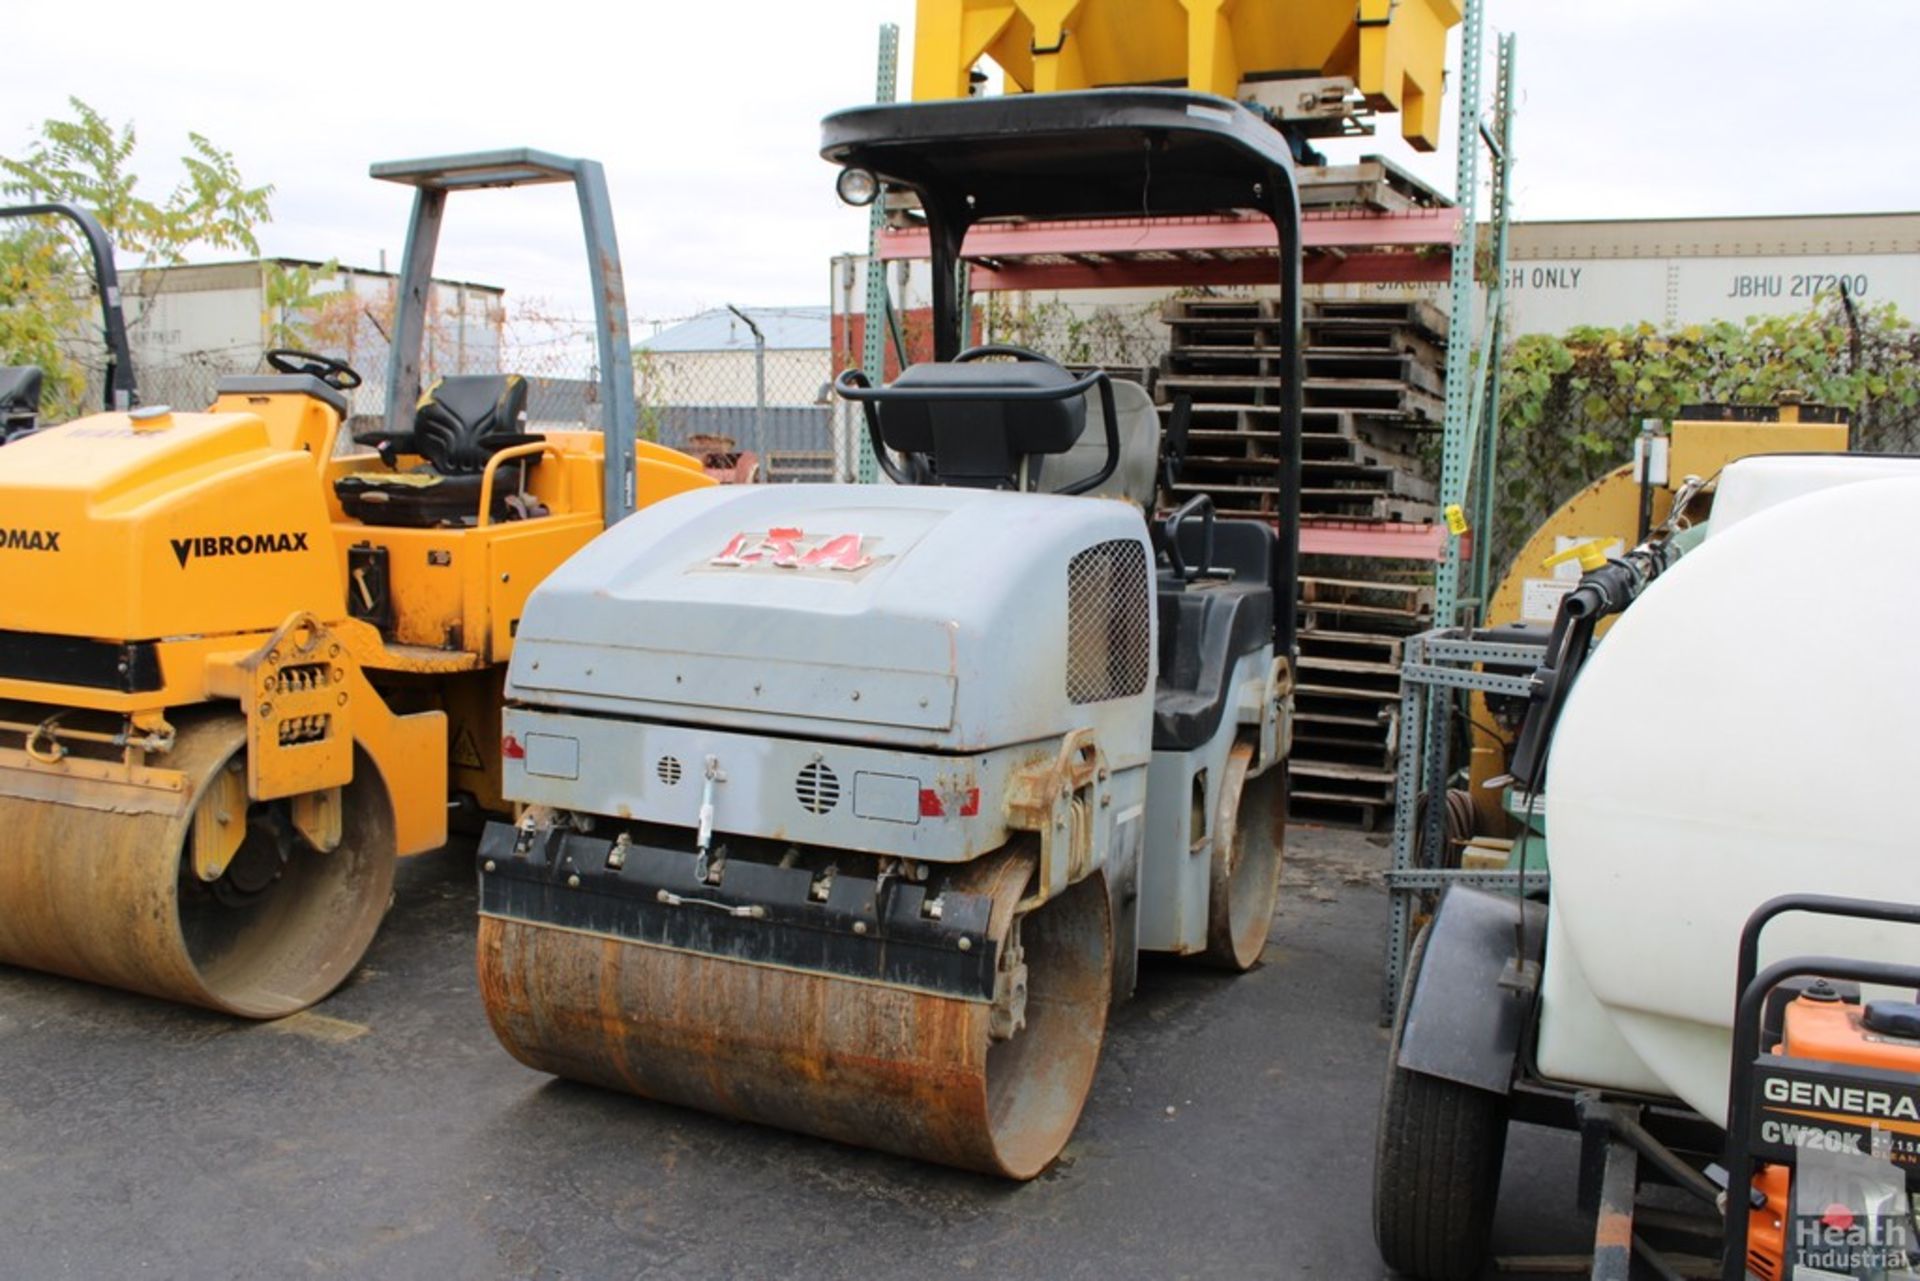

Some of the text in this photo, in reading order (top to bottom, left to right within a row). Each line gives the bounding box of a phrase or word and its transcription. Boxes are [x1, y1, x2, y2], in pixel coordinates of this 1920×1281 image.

[1532, 267, 1583, 290] ONLY
[1728, 274, 1868, 298] JBHU 217200
[170, 532, 308, 570] VIBROMAX
[1761, 1120, 1862, 1155] CW20K
